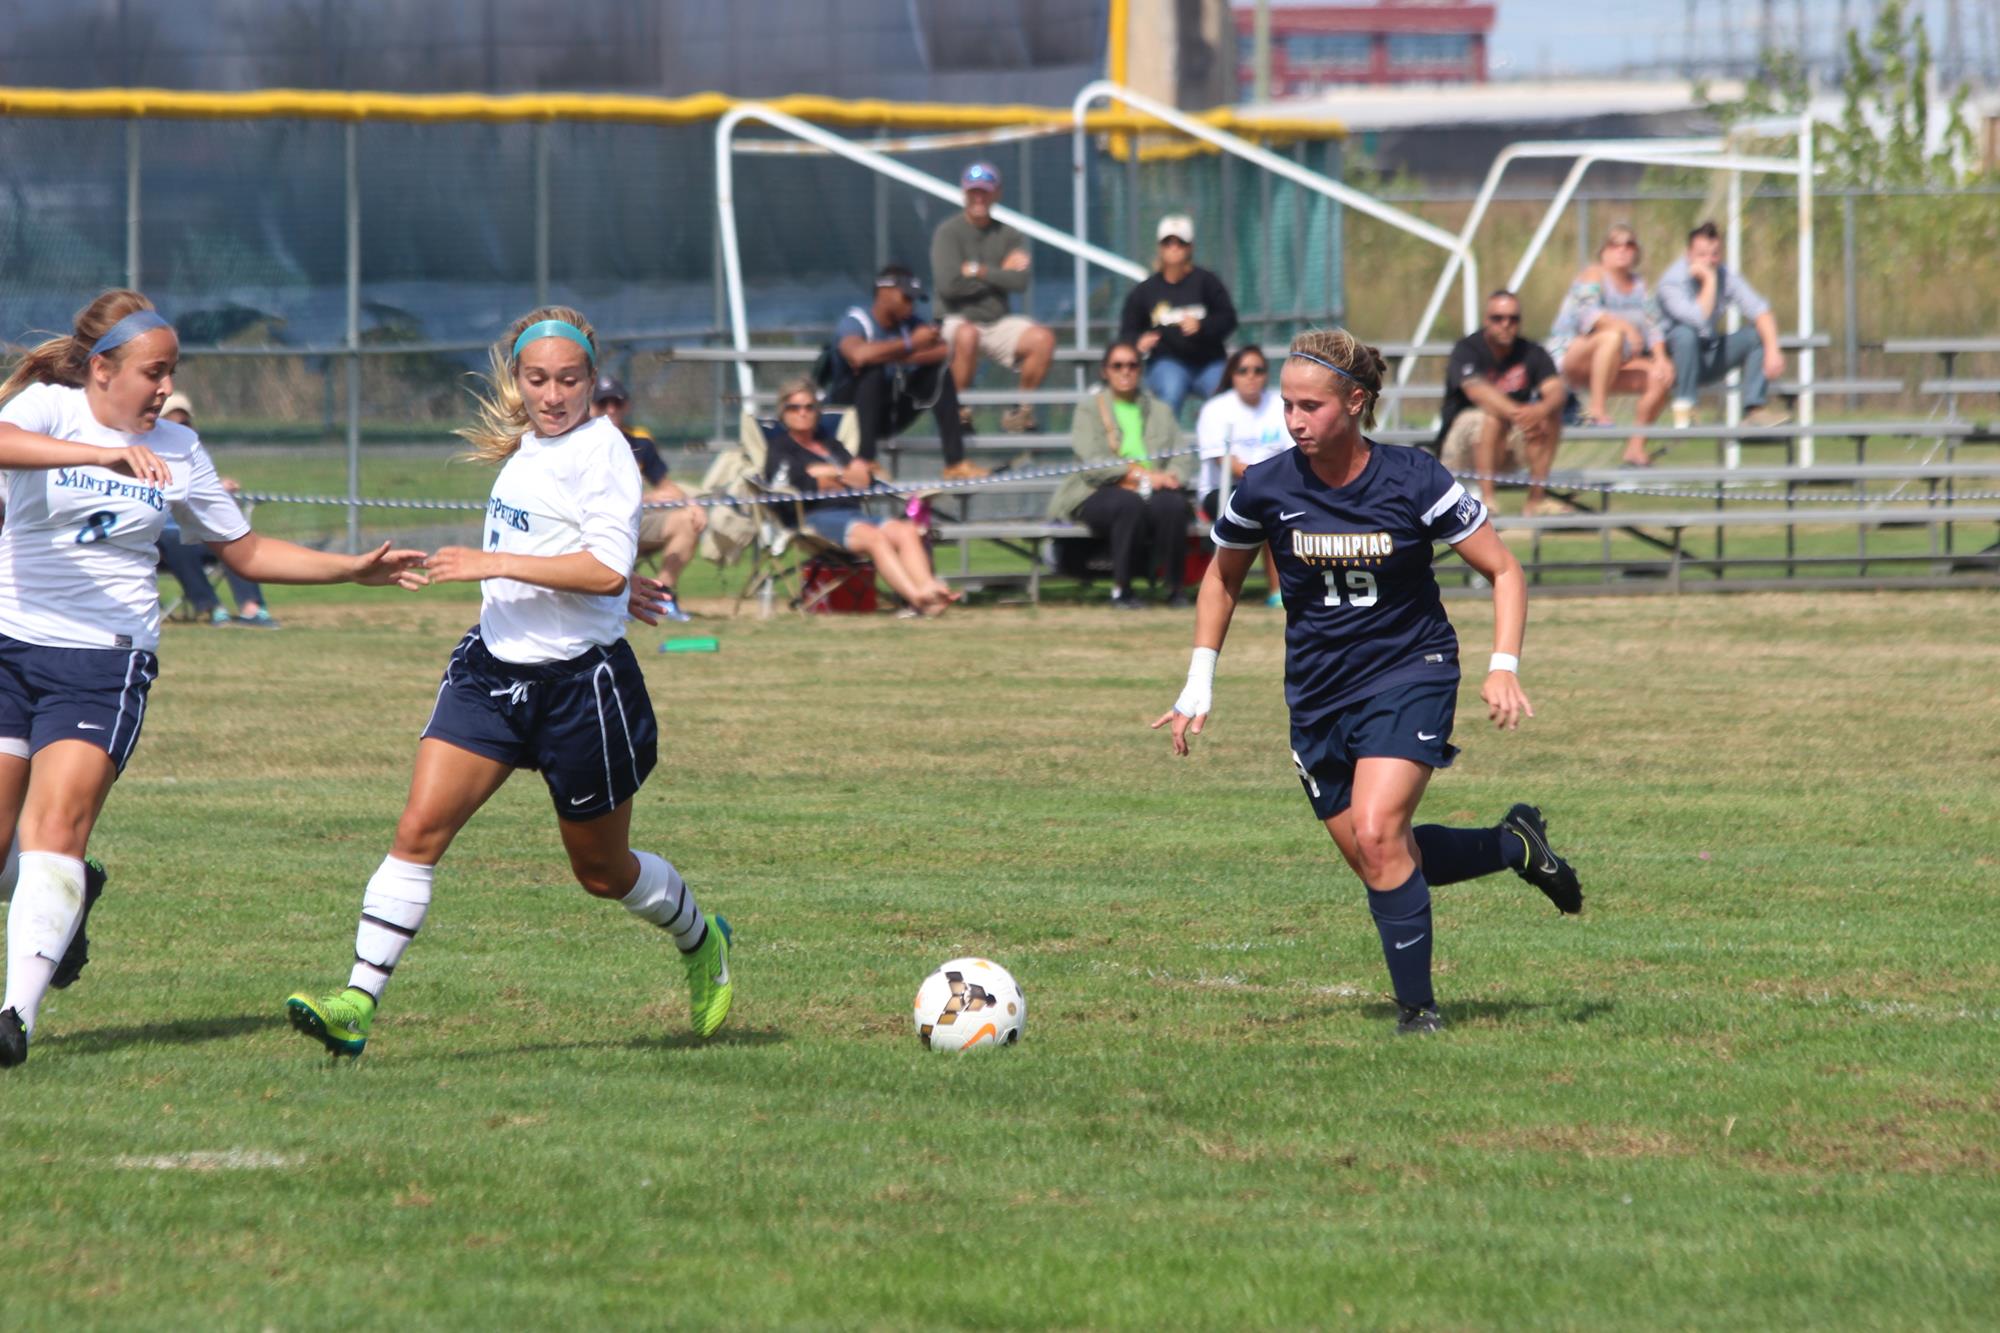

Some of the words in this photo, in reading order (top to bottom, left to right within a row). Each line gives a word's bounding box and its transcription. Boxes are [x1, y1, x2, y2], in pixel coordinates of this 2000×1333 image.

[75, 510, 118, 544] 8
[1292, 528, 1394, 566] QUINNIPIAC
[1321, 570, 1378, 607] 19
